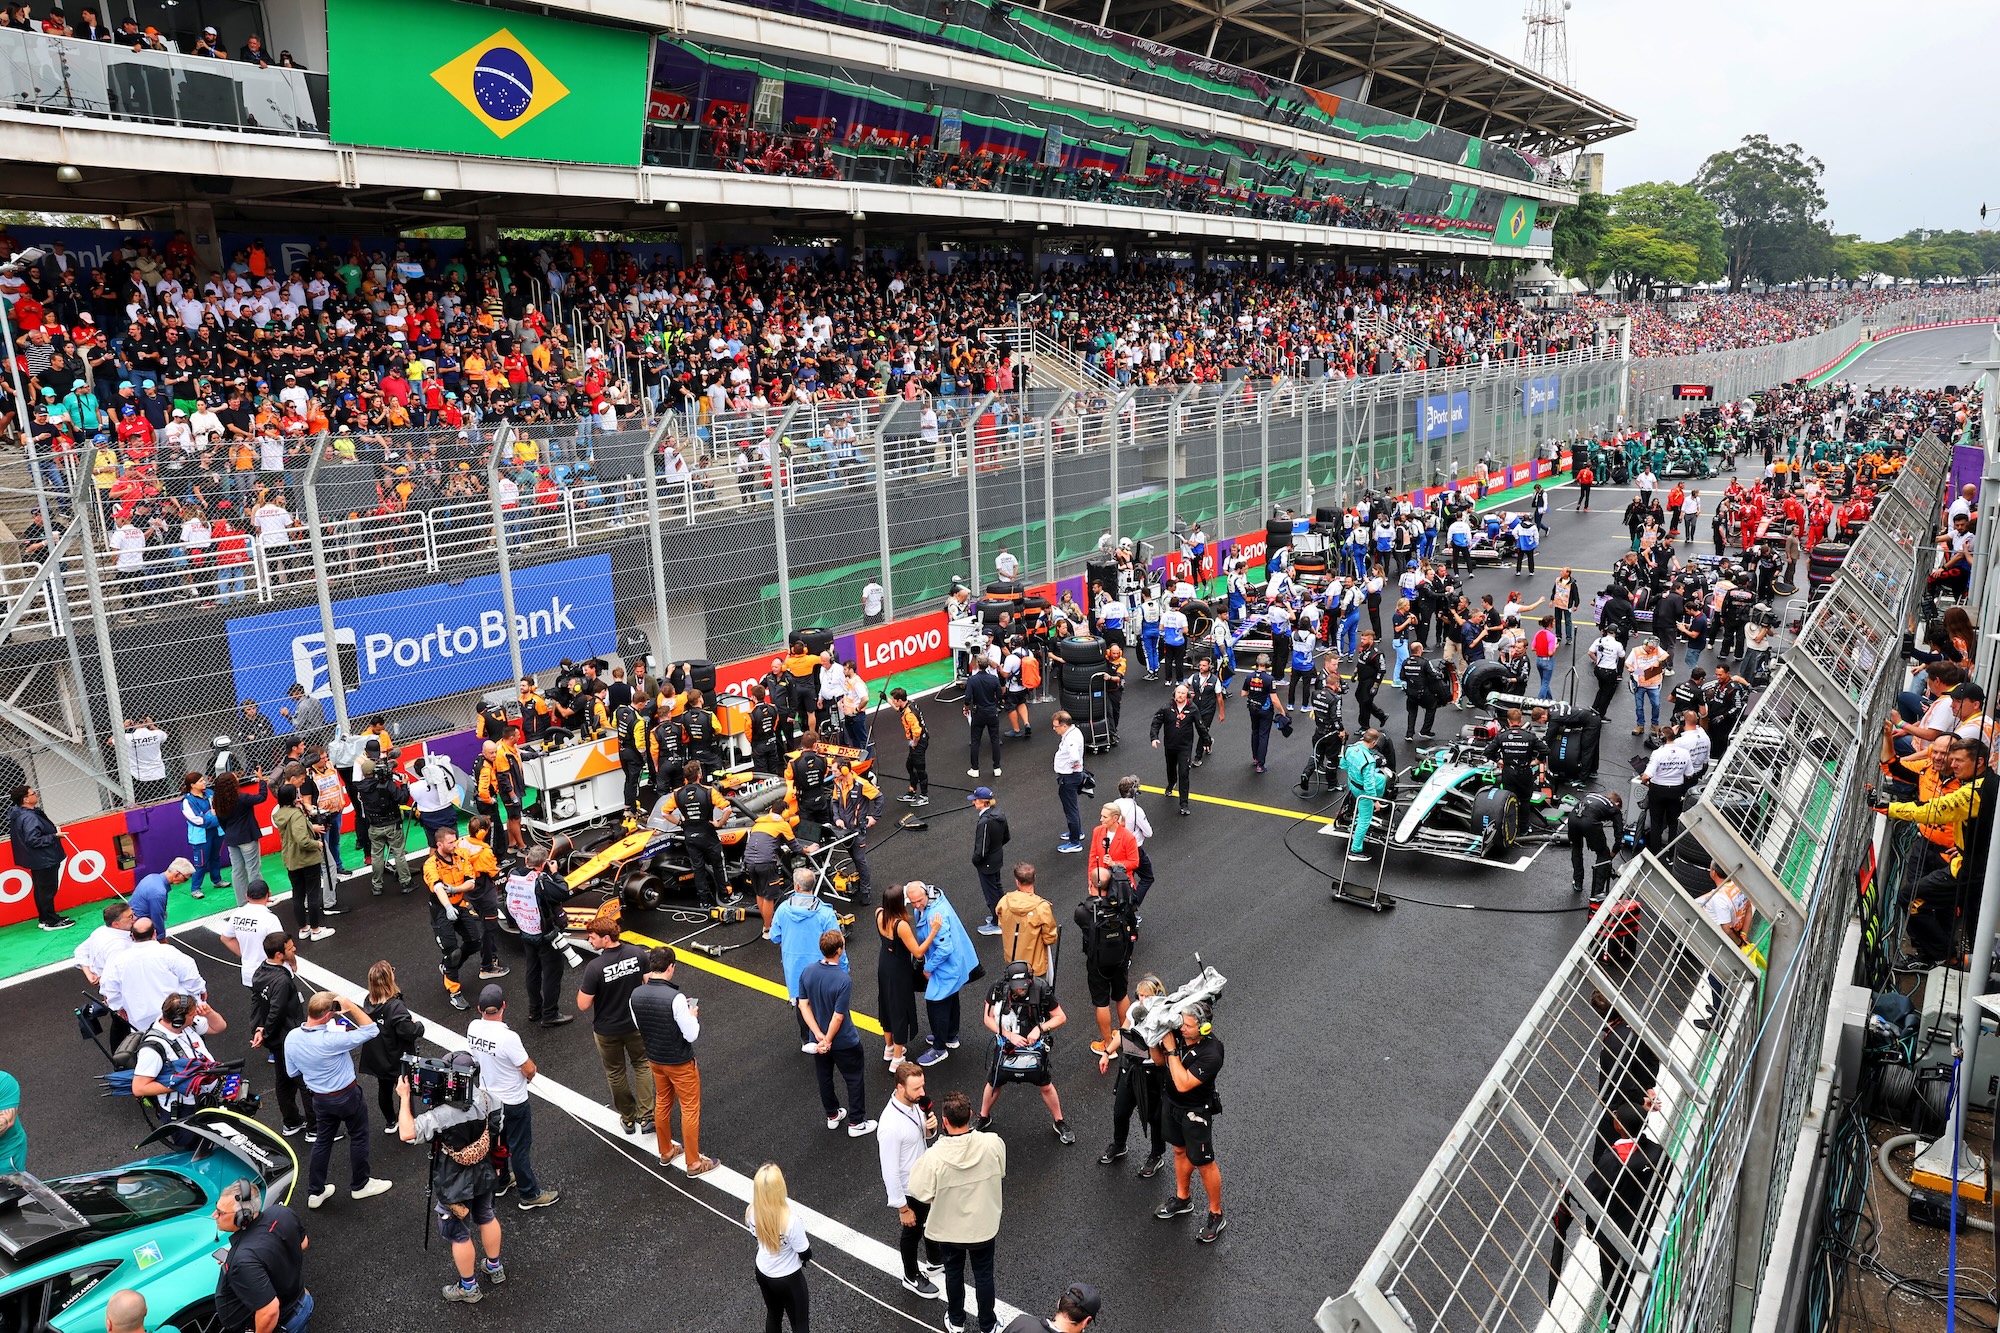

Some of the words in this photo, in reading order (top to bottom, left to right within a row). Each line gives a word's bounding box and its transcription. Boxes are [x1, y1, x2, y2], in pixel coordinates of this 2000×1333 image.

[1535, 385, 1555, 402] Portoank
[1433, 405, 1463, 425] Portoank
[1514, 468, 1530, 482] Lenovo
[1458, 483, 1477, 500] Lenovo
[1239, 541, 1268, 560] Lenov
[364, 596, 575, 674] PortoBank
[863, 628, 941, 669] Lenovo
[130, 735, 159, 744] STAFF
[739, 776, 781, 797] Chrome
[602, 956, 639, 978] STAFF
[61, 1278, 100, 1309] B.MAYLANDER
